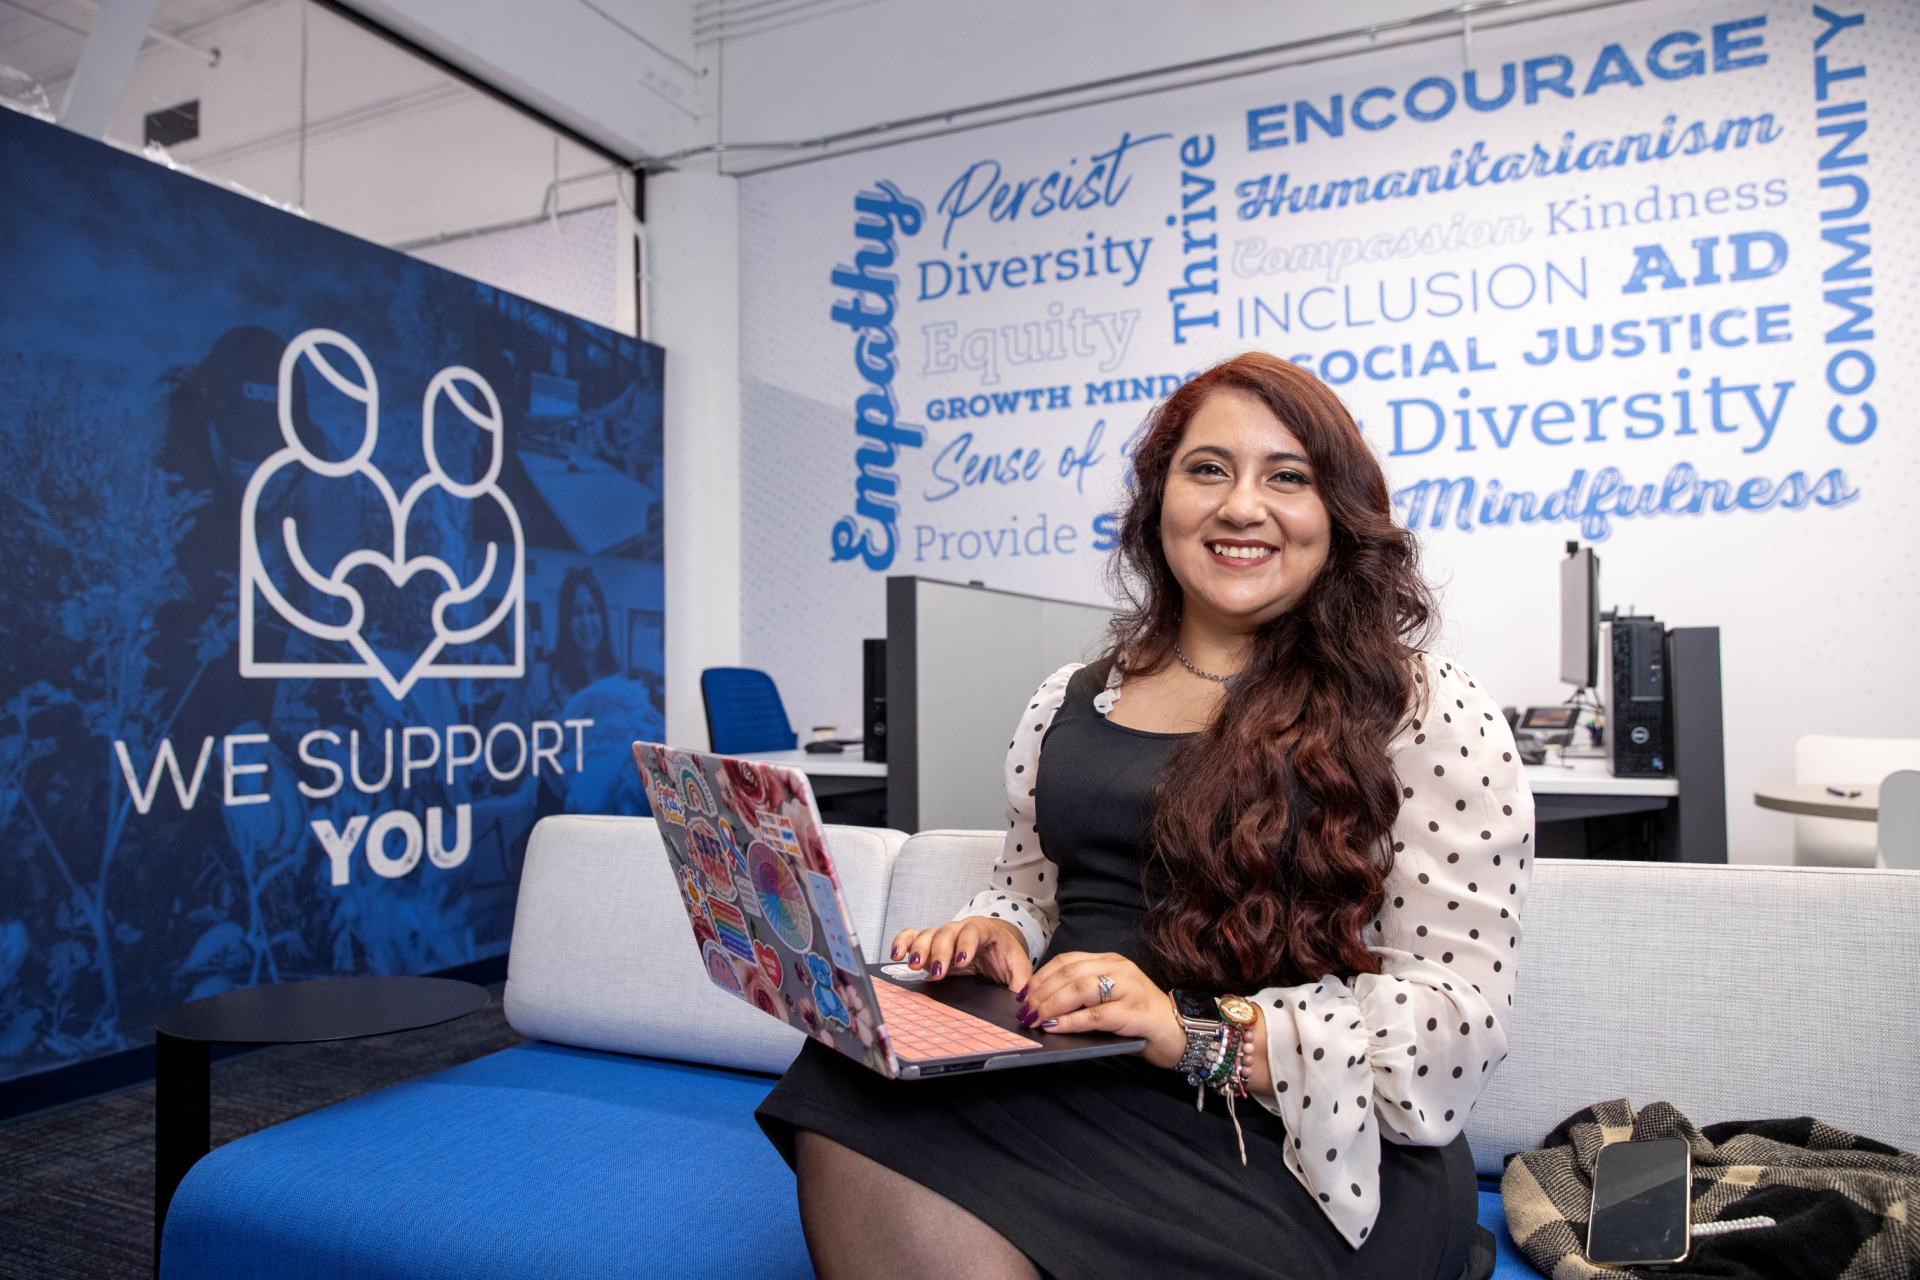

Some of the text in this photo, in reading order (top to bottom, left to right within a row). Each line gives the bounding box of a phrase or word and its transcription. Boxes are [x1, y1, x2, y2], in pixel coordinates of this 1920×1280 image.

[1246, 15, 1769, 152] ENCOURAGE
[937, 132, 1175, 250] Persist
[1236, 112, 1784, 222] Humanitarianism
[1547, 177, 1790, 237] Kindness
[918, 231, 1154, 302] Diversity
[1166, 134, 1219, 344] Thrive
[1231, 211, 1535, 284] Compassion
[1621, 230, 1790, 295] AID
[1812, 4, 1879, 445] COMMUNITY
[1236, 256, 1589, 339] INCLUSION
[1523, 303, 1794, 367] JUSTICE
[830, 178, 929, 572] Empathy
[921, 301, 1141, 386] Equity
[925, 371, 1200, 422] GROWTH MIND
[1387, 366, 1797, 457] Diversity
[923, 433, 1046, 502] Sense
[1058, 418, 1106, 493] of
[1392, 461, 1861, 542] Mindfulness
[914, 514, 1078, 562] Provide
[114, 719, 595, 815] WE SUPPORT
[311, 803, 472, 887] YOU
[691, 829, 726, 865] SAFE
